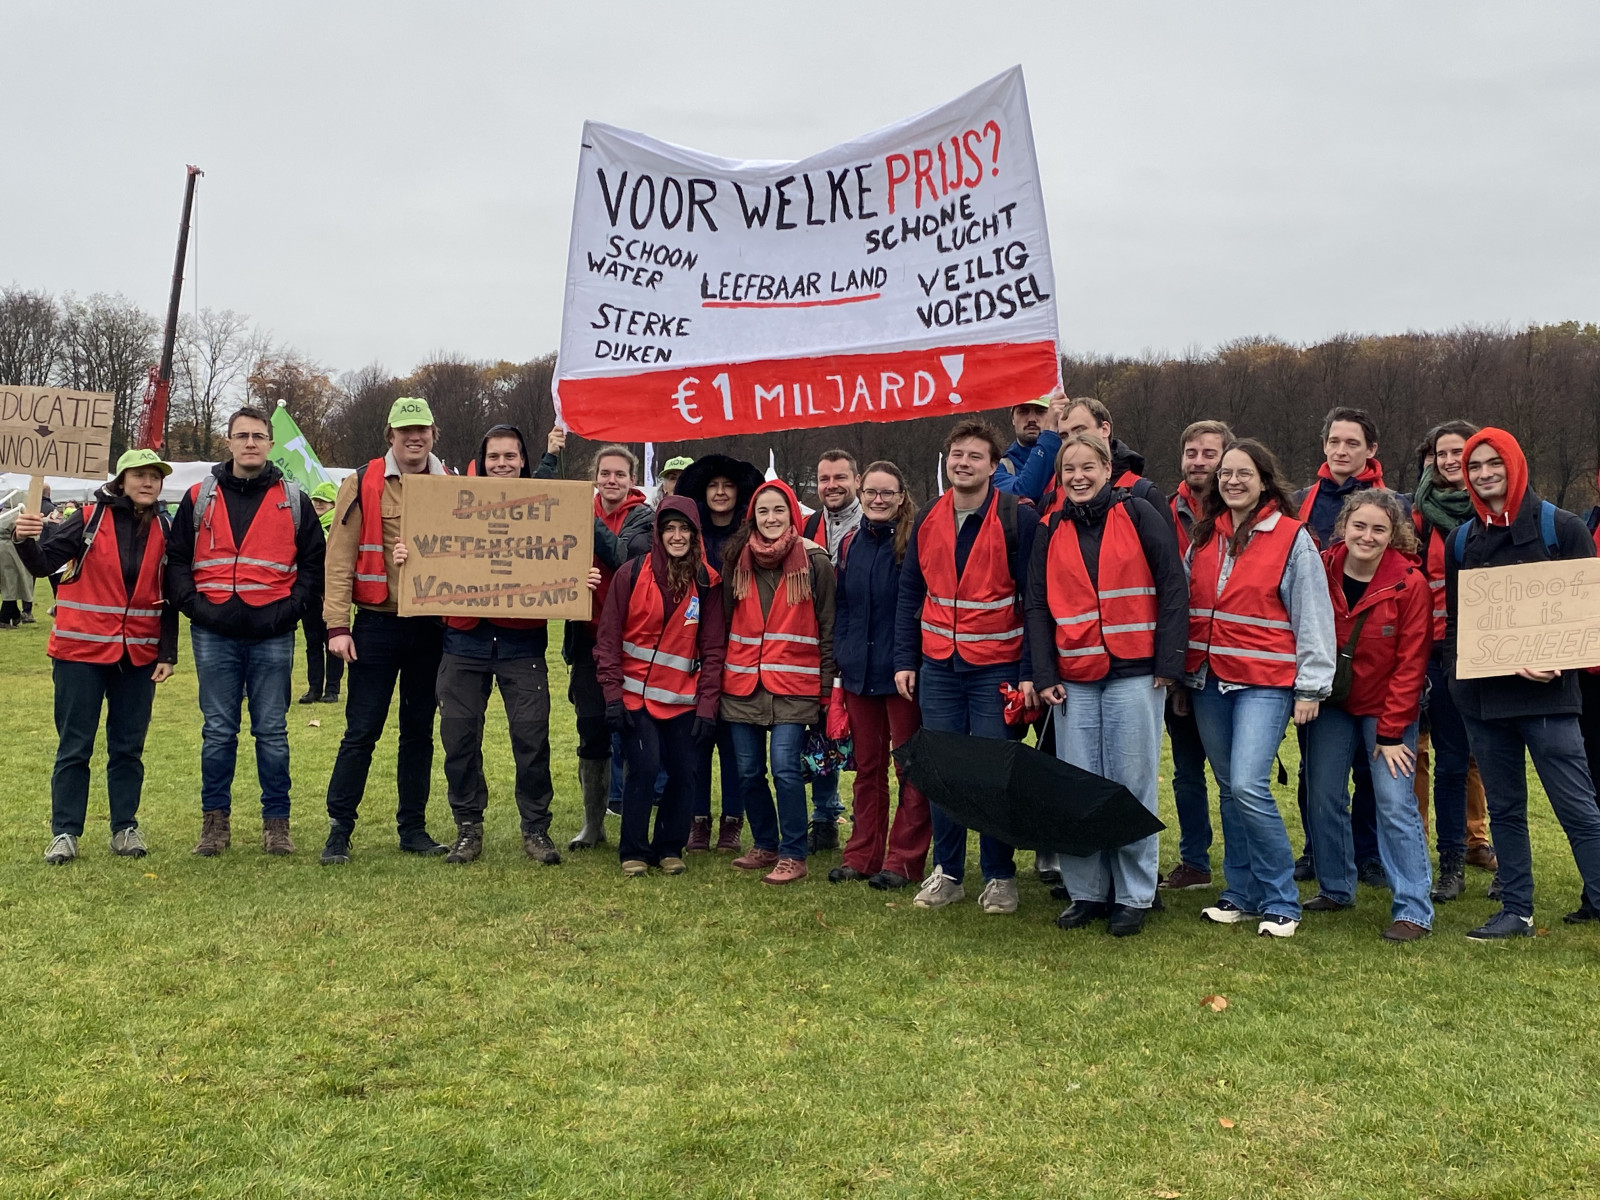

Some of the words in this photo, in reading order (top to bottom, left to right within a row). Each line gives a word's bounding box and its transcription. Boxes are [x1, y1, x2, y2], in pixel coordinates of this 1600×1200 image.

[597, 168, 718, 232] VOOR
[731, 163, 879, 230] WELKE
[885, 120, 1001, 215] PRIJS?
[866, 193, 975, 254] SCHONE
[937, 202, 1017, 253] LUCHT
[587, 251, 664, 291] WATER
[606, 235, 698, 271] SCHOON
[917, 241, 1030, 297] VEILIG
[700, 272, 822, 300] LEEFBAAR
[831, 266, 887, 292] LAND
[916, 273, 1051, 329] VOEDSEL
[590, 303, 692, 337] STERKE
[595, 340, 672, 363] DIJKEN
[753, 353, 965, 421] MILJARD!
[0, 391, 112, 428] DUCATIE
[413, 534, 578, 560] WETENSCHAP
[1464, 571, 1590, 607] Schoof,
[1477, 605, 1517, 631] dit
[1541, 601, 1563, 625] is
[1470, 627, 1600, 665] SCHEEF
